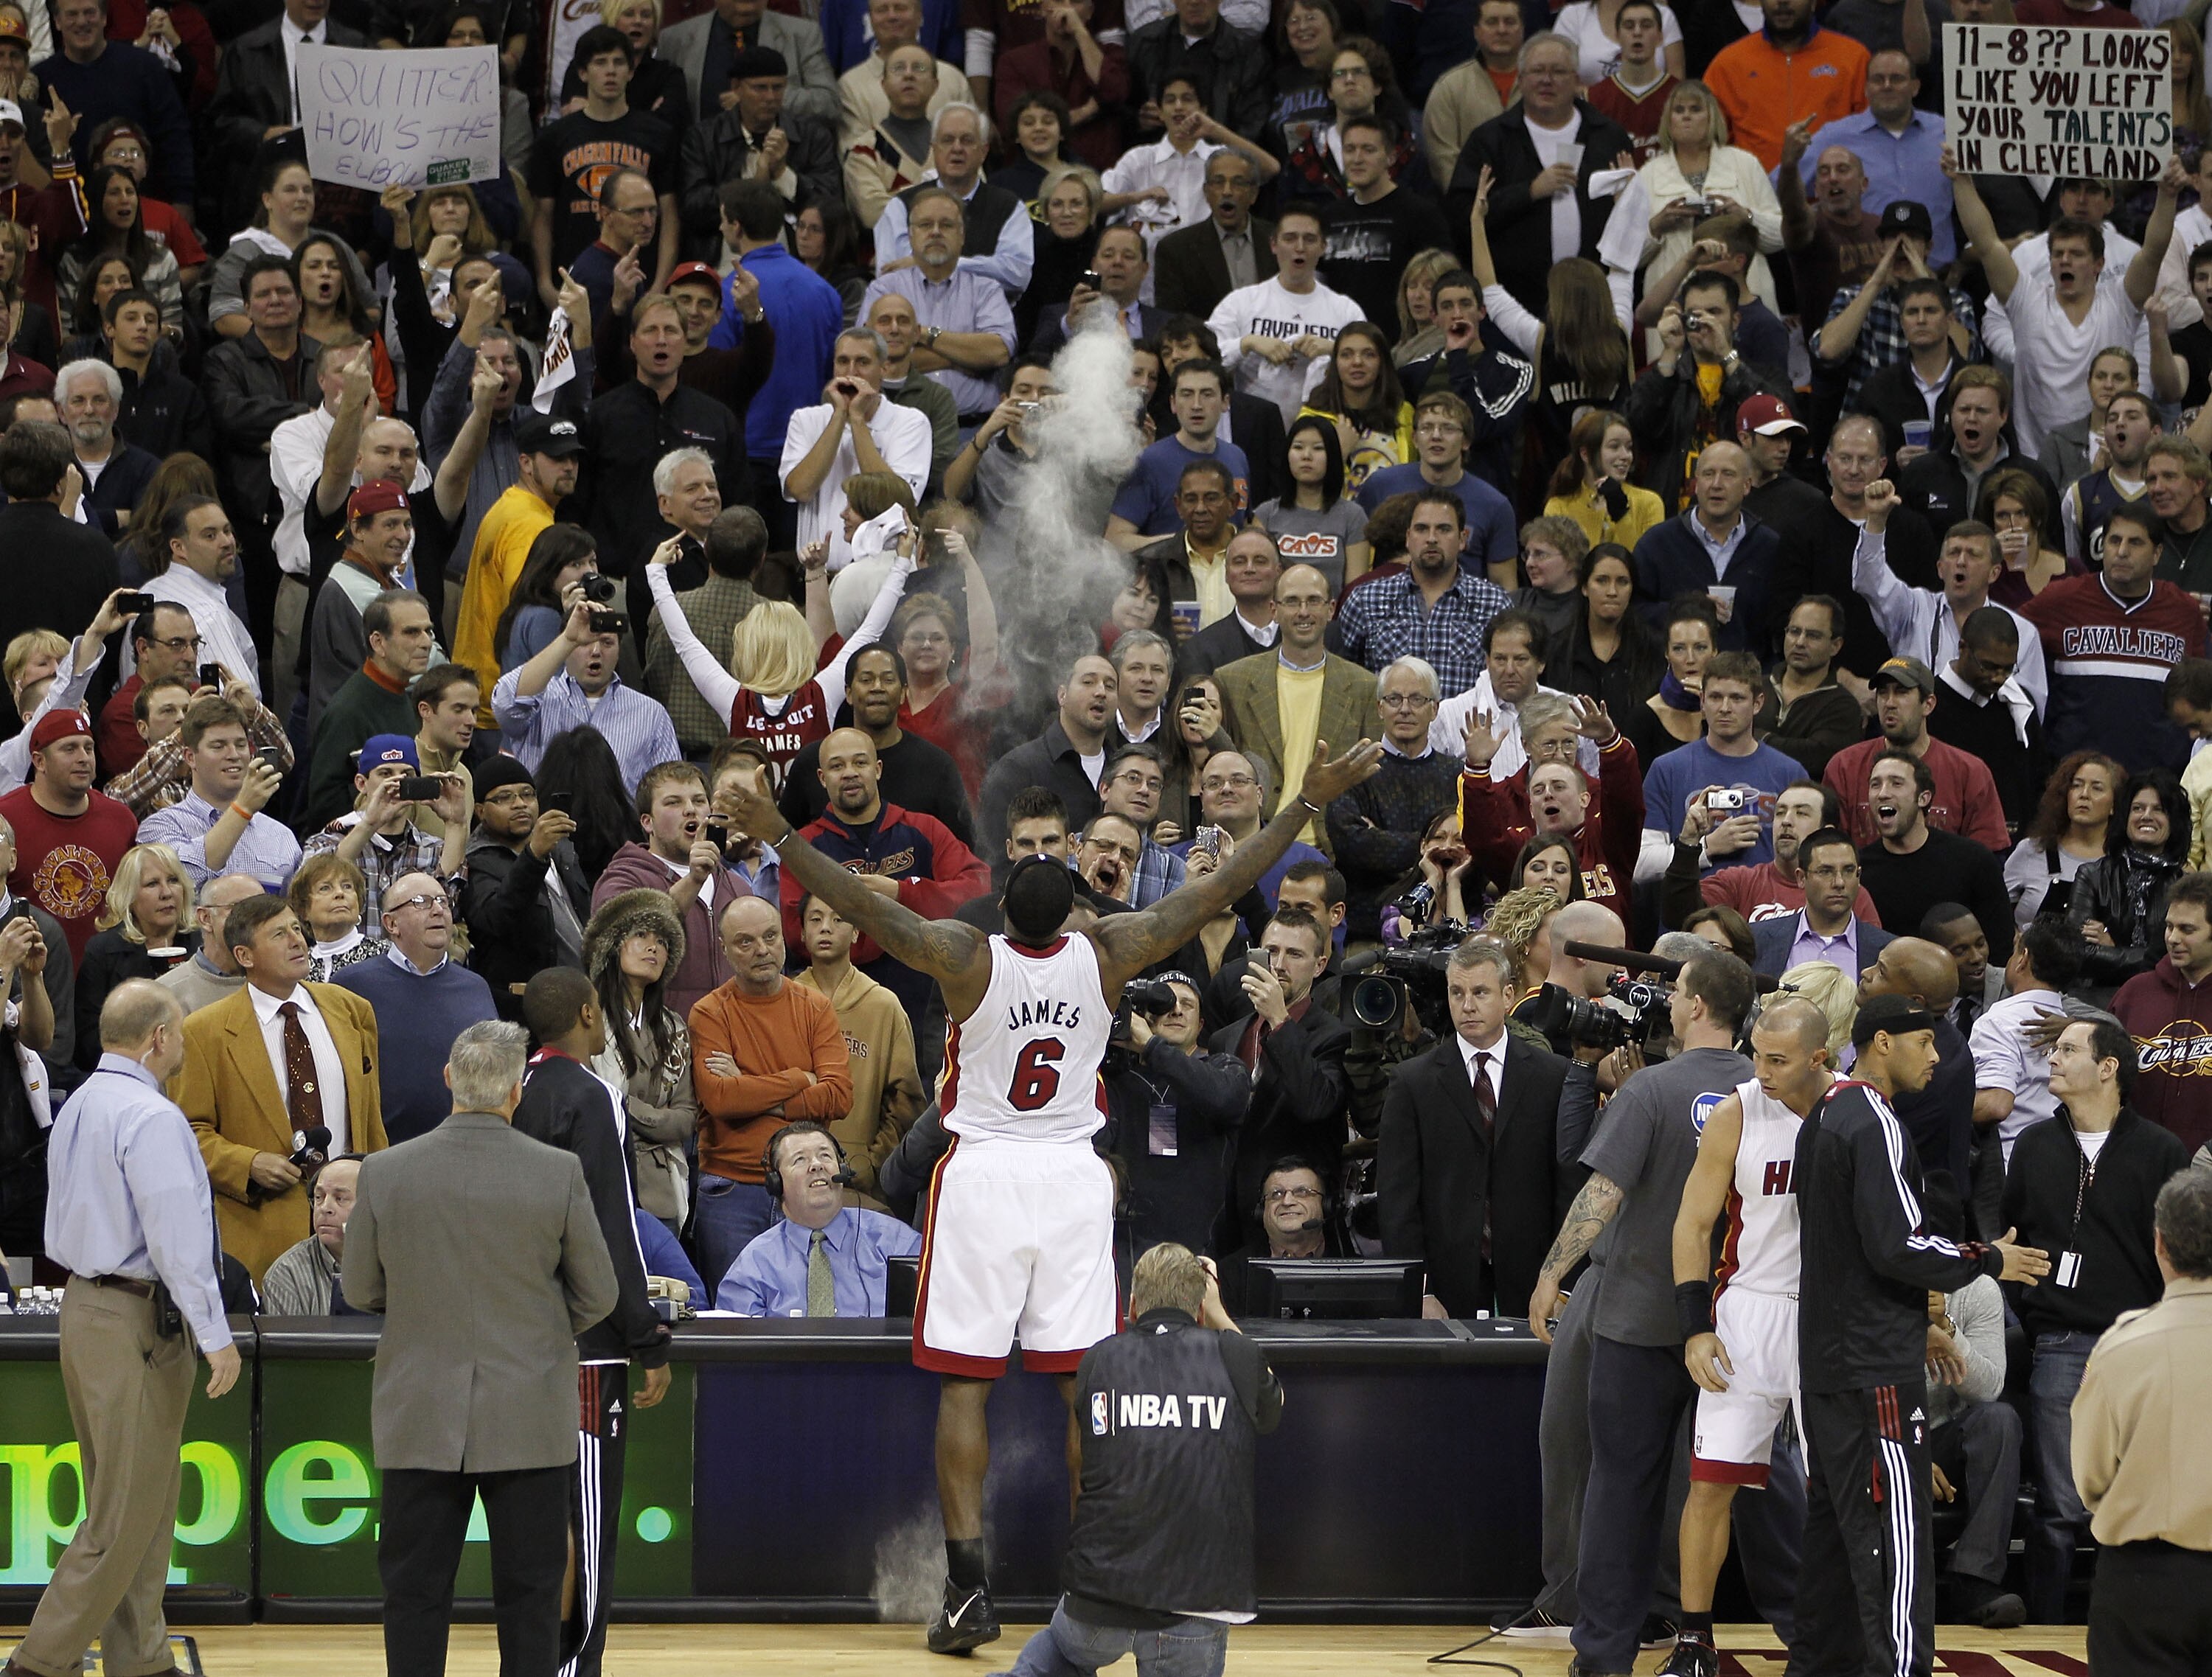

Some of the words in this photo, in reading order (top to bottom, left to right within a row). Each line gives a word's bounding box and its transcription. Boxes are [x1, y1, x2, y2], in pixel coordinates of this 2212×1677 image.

[1956, 26, 2070, 68] 11-8??
[2082, 32, 2170, 72] LOOKS
[319, 53, 495, 108] QUITTER!
[1955, 70, 2017, 104] LIKE
[2029, 70, 2079, 107] YOU
[2089, 73, 2163, 108] LEFT
[316, 111, 421, 154] HOW'S
[427, 112, 498, 147] THE
[1957, 106, 2025, 140] YOUR
[2043, 109, 2171, 147] TALENTS
[1957, 139, 1982, 172] IN
[1999, 142, 2161, 179] CLEVELAND
[1278, 534, 1336, 554] CAVS
[2064, 627, 2185, 664] CAVALIERS
[33, 845, 111, 891] CAVALIERS
[1159, 972, 1173, 983] EST.
[1008, 999, 1081, 1031] JAMES
[1632, 991, 1649, 1003] TNT
[2138, 1036, 2212, 1070] CAVALIER
[1007, 1036, 1066, 1112] 6
[1121, 1394, 1182, 1427] NBA
[1187, 1395, 1227, 1430] TV
